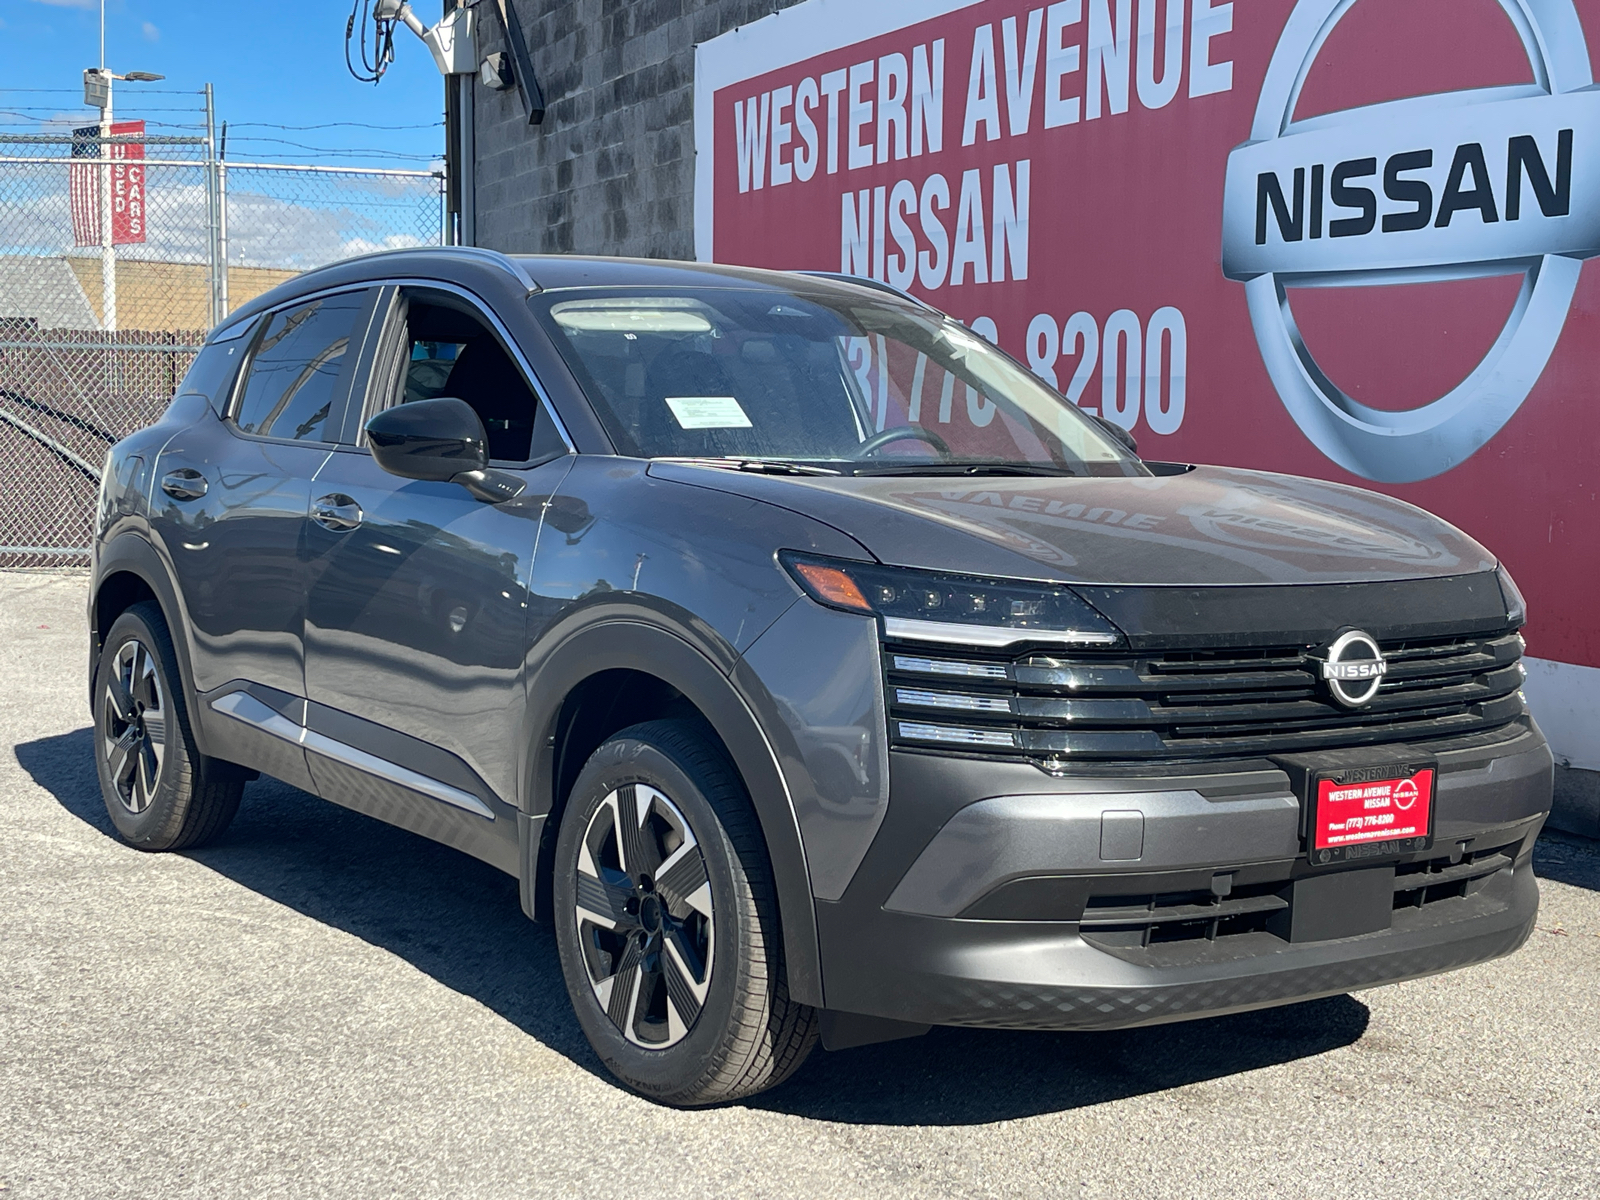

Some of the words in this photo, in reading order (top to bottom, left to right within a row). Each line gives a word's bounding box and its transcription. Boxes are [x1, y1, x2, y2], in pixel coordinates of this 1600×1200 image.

[734, 38, 945, 193] WESTERN
[962, 0, 1235, 147] AVENUE
[114, 145, 125, 213] USED
[1255, 128, 1574, 245] NISSAN
[129, 167, 141, 234] CARS
[841, 159, 1031, 291] NISSAN
[1325, 662, 1386, 677] NISSAN
[1329, 789, 1363, 802] WESTERN
[1363, 786, 1391, 798] AVENUE
[1364, 797, 1390, 809] NISSAN
[1393, 790, 1418, 798] NISSAN
[1346, 817, 1363, 831] (773)
[1364, 813, 1394, 826] 776-8200
[1346, 841, 1400, 859] NISSAN
